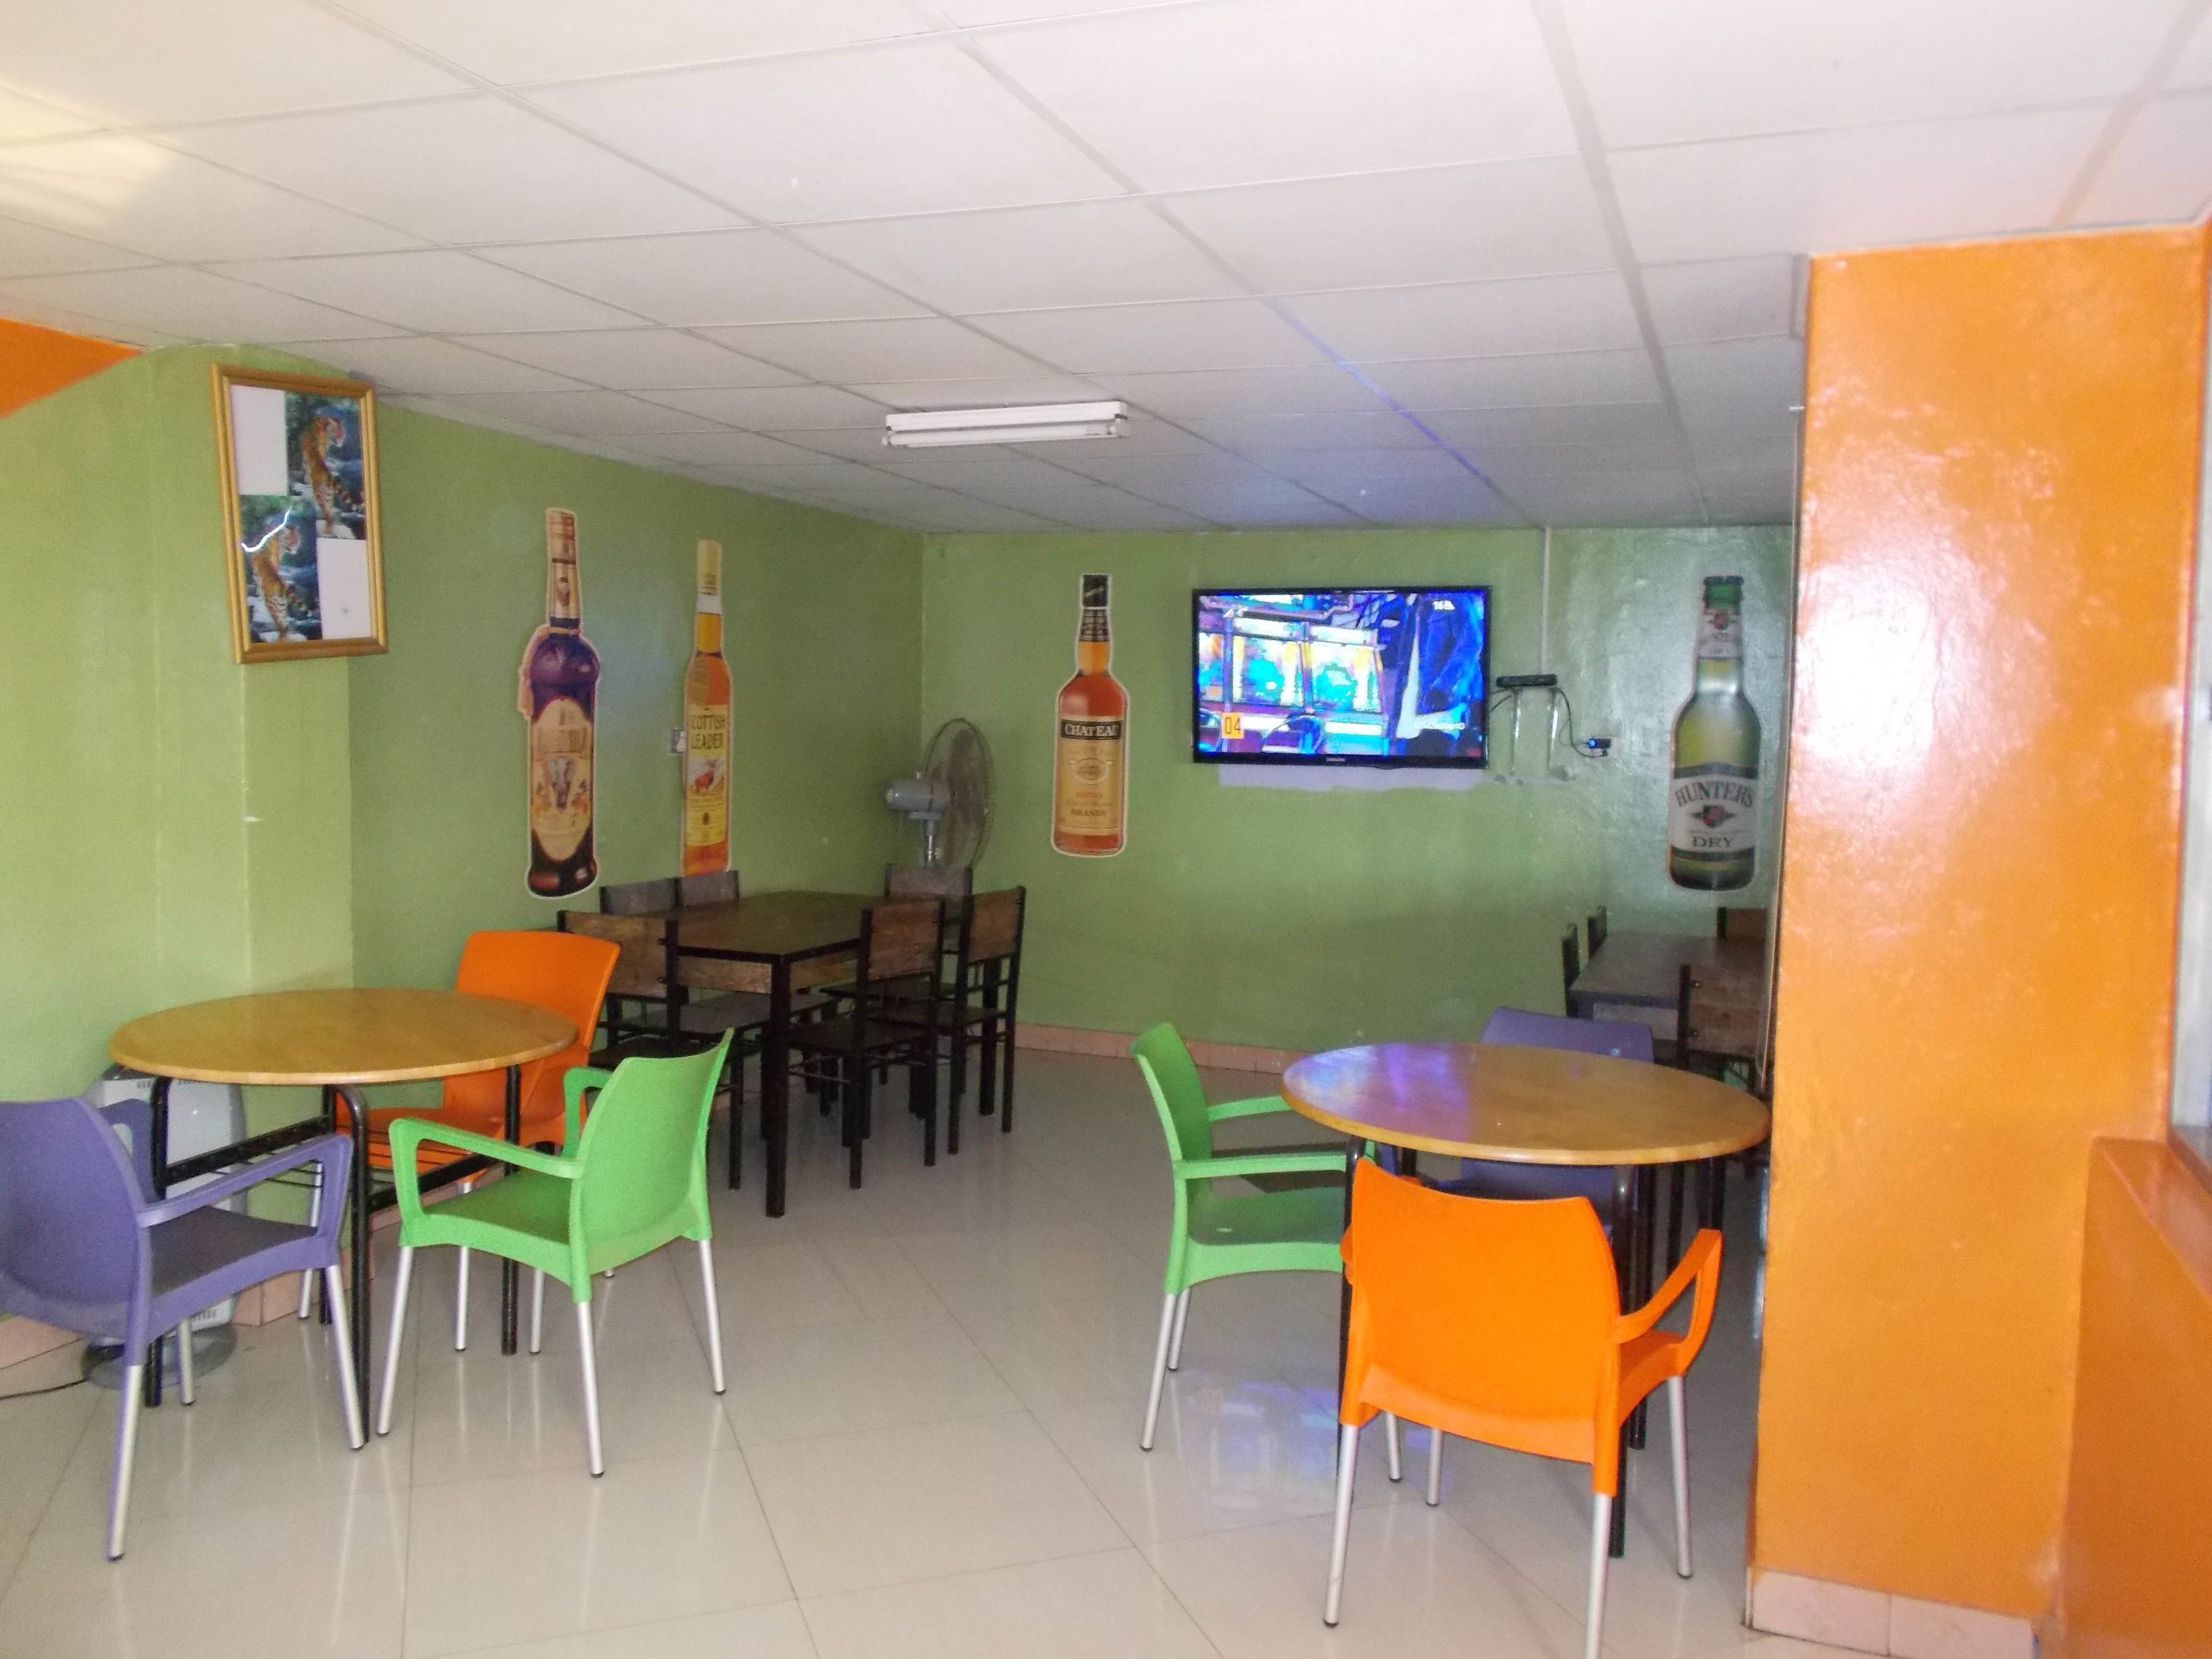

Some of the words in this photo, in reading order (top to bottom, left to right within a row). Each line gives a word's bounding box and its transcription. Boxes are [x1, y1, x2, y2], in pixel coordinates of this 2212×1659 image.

[1225, 717, 1241, 734] 04
[691, 733, 724, 749] LEADER
[1692, 836, 1734, 847] DRY
